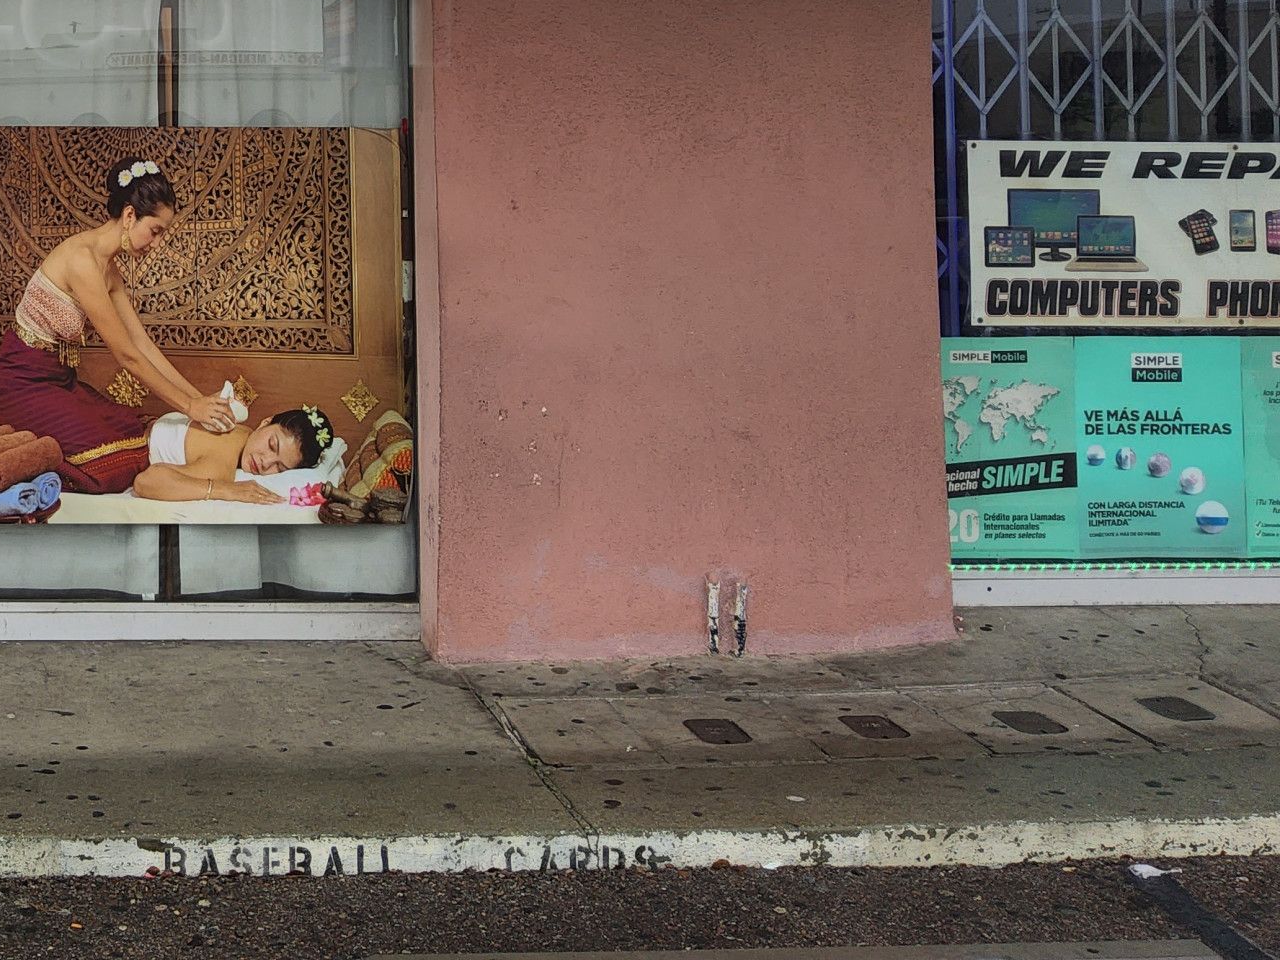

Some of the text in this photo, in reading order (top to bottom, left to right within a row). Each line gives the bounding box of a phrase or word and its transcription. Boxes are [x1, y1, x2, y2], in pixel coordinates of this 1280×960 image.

[999, 149, 1111, 178] WE
[985, 278, 1182, 318] COMPUTERS
[952, 352, 1026, 361] SIMPLE Mobile
[1134, 355, 1180, 366] SIMPLE
[1135, 370, 1179, 381] Mobile
[1084, 407, 1184, 422] VE MÁS ALLÁ
[1085, 423, 1232, 435] DE LAS FRONTERAS
[981, 460, 1065, 489] SIMPLE
[948, 480, 979, 492] hecho
[1087, 501, 1186, 510] CON LARGA DISTANCIA
[983, 512, 1066, 523] Crédito para Llamadas
[1088, 510, 1157, 518] INTERNACIONAL
[994, 532, 1016, 540] planes
[1018, 531, 1046, 539] selectos
